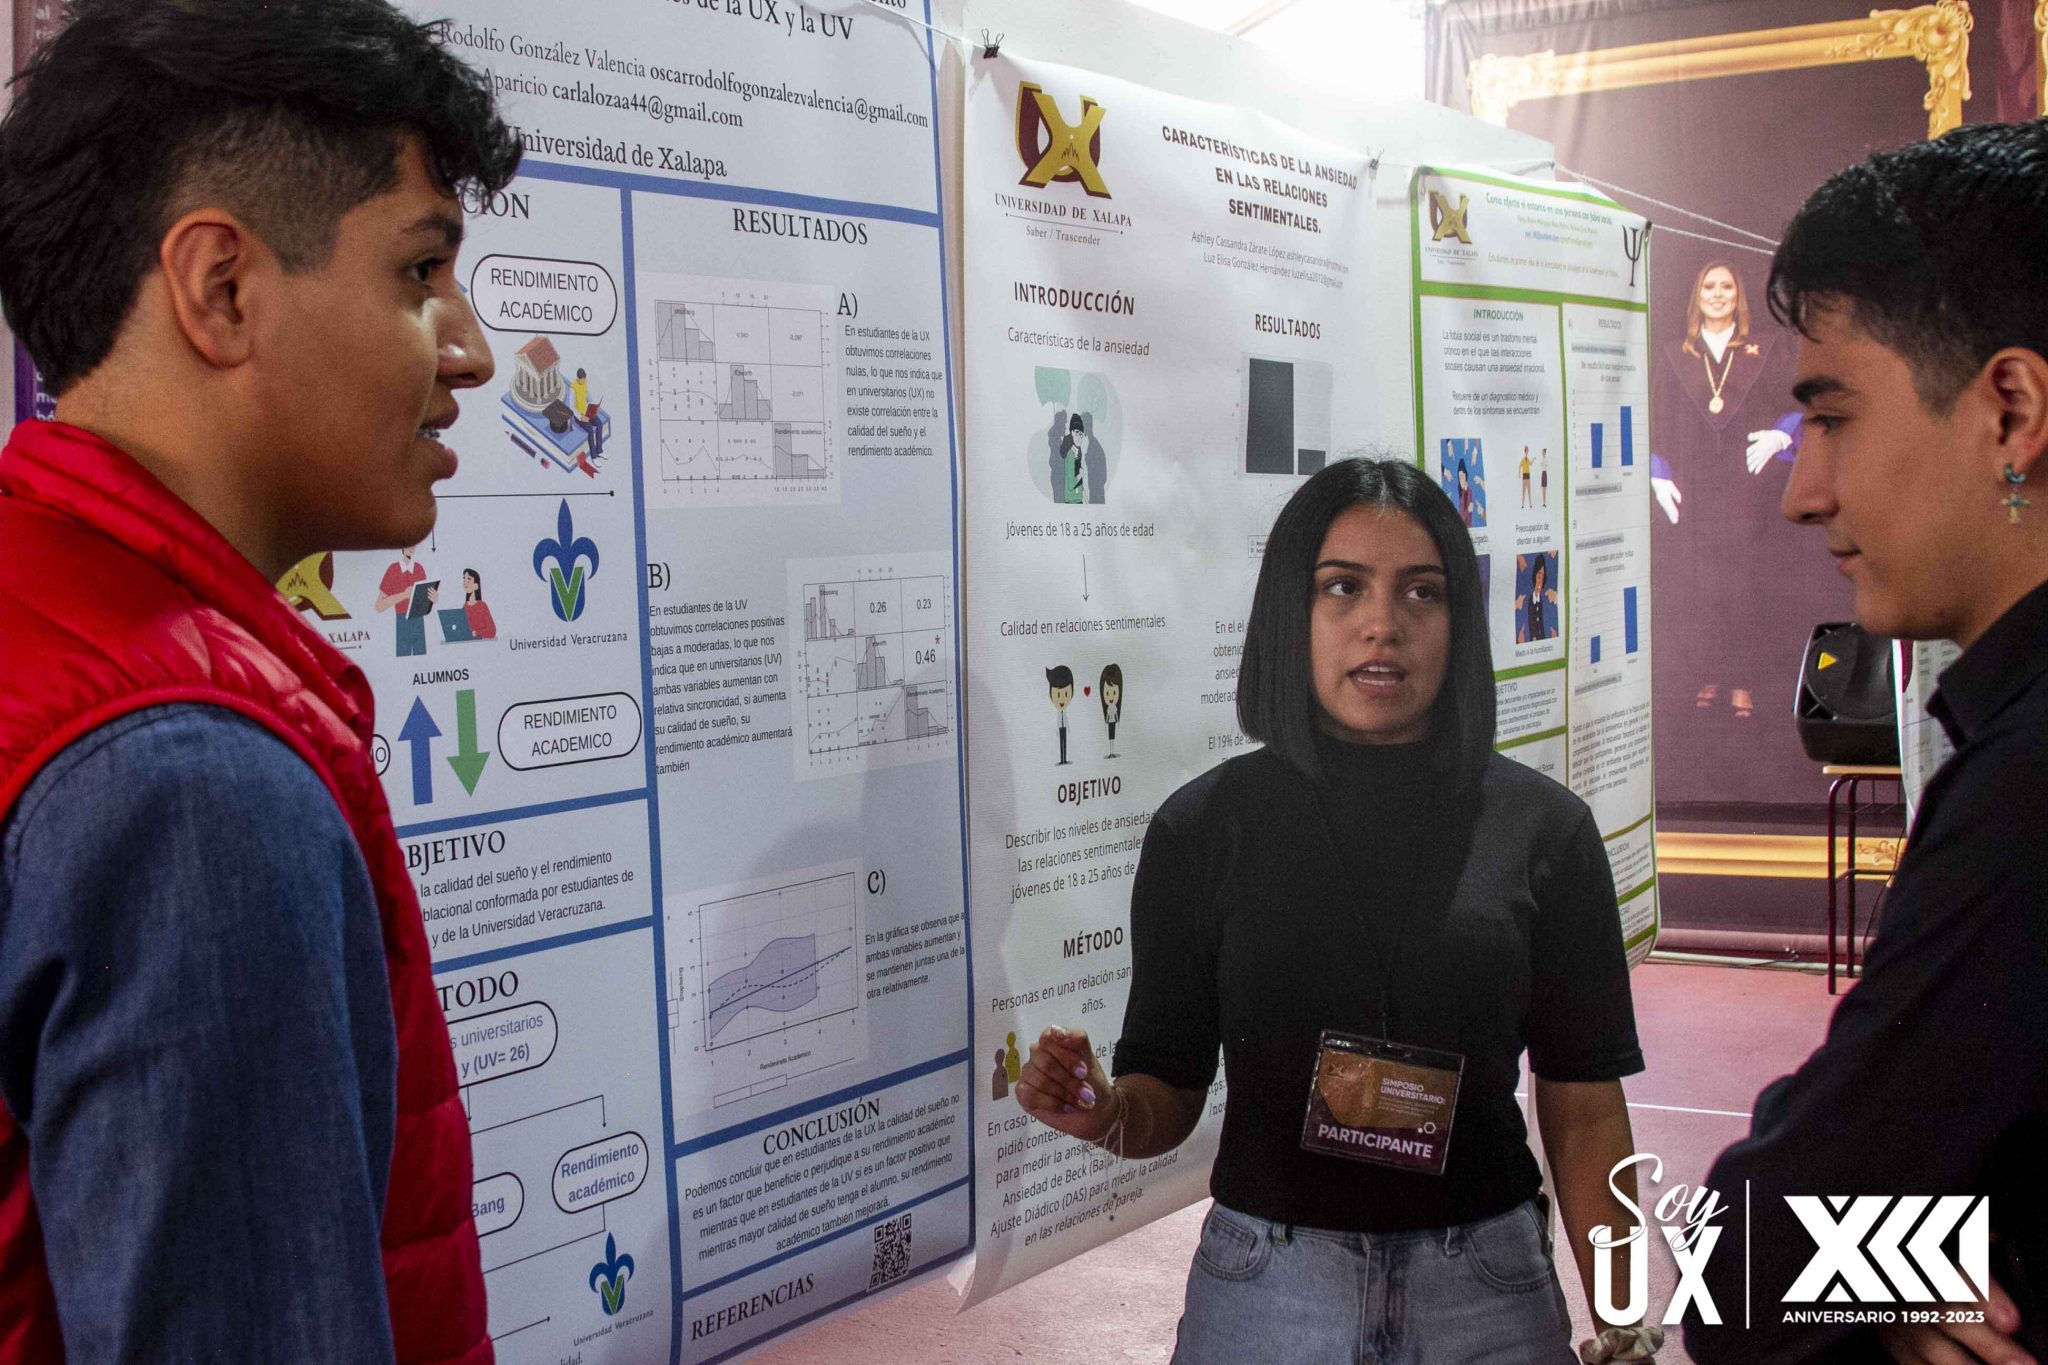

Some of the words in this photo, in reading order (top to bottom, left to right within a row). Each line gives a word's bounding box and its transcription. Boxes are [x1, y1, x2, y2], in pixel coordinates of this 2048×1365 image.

[750, 0, 780, 24] UX
[785, 12, 795, 36] y
[801, 5, 815, 33] la
[821, 13, 853, 40] UV
[441, 23, 504, 52] Rodolfo
[510, 35, 580, 65] González
[585, 48, 645, 77] Valencia
[650, 66, 928, 128] oscarrodolfogonzalezvalencia@gmail.com
[483, 68, 547, 97] Aparicio
[553, 82, 743, 127] carlalozaa44@gmail.com
[632, 145, 653, 167] de
[658, 147, 727, 179] Xalapa
[1280, 155, 1295, 171] DE
[1298, 159, 1312, 176] LA
[1315, 164, 1357, 190] ANSIEDAD
[1216, 167, 1233, 185] EN
[1237, 170, 1260, 190] LAS
[1263, 178, 1327, 208] RELACIONES
[995, 193, 1066, 217] UNIVERSIDAD
[1072, 205, 1087, 220] DE
[1093, 209, 1132, 227] XALAPA
[1229, 199, 1321, 234] SENTIMENTALES.
[732, 208, 868, 244] RESULTADOS
[1026, 225, 1047, 238] Saber
[1056, 229, 1101, 246] Trascender
[1192, 232, 1214, 247] Ashley
[1216, 236, 1247, 251] Cassandra
[1249, 241, 1268, 255] Zárate
[1269, 246, 1285, 259] López
[491, 268, 598, 292] RENDIMIENTO
[499, 300, 593, 322] ACADÉMICO
[837, 293, 858, 319] A)
[1014, 281, 1134, 315] INTRODUCCIÓN
[1255, 313, 1321, 340] RESULTADOS
[1474, 309, 1523, 321] INTRODUCCIÓN
[845, 325, 856, 336] En
[858, 326, 899, 339] estudiantes
[901, 328, 909, 339] de
[911, 328, 918, 340] la
[920, 331, 930, 341] UX
[1077, 336, 1089, 351] de
[1092, 337, 1101, 352] la
[1104, 339, 1149, 356] ansiedad
[846, 347, 884, 359] obtuvimos
[886, 348, 931, 360] correlaciones
[849, 444, 892, 457] rendimiento
[1006, 521, 1043, 539] Jóvenes
[1046, 522, 1057, 537] de
[1060, 523, 1070, 536] 18
[1073, 526, 1079, 536] a
[1081, 523, 1092, 536] 25
[1095, 521, 1118, 536] años
[1121, 523, 1130, 536] de
[1133, 523, 1154, 537] edad
[648, 563, 671, 589] B)
[650, 605, 661, 617] En
[663, 601, 710, 615] estudiantes
[712, 601, 723, 612] de
[725, 600, 733, 611] la
[735, 599, 747, 610] UV
[870, 601, 886, 614] 0.26
[916, 598, 931, 610] 0.23
[651, 622, 693, 637] obtuvimos
[695, 618, 749, 634] correlaciones
[751, 615, 784, 631] positivas
[1001, 620, 1038, 636] Calidad
[1040, 623, 1053, 634] en
[1055, 618, 1103, 634] relaciones
[1105, 614, 1165, 630] sentimentales
[509, 636, 566, 652] Universidad
[571, 632, 628, 645] Veracruzana
[915, 649, 936, 664] 0.46
[412, 668, 469, 686] ALUMNOS
[524, 704, 617, 730] RENDIMIENTO
[531, 733, 612, 757] ACADEMICO
[655, 738, 704, 755] rendimiento
[706, 732, 749, 750] académico
[752, 726, 793, 745] aumentará
[656, 759, 689, 775] también
[1058, 775, 1121, 806] OBJETIVO
[406, 830, 506, 875] BJETIVO
[420, 884, 431, 898] la
[434, 875, 473, 896] calidad
[477, 871, 494, 888] del
[496, 866, 528, 884] sueño
[531, 864, 538, 878] y
[541, 860, 550, 875] el
[552, 851, 612, 872] rendimiento
[868, 869, 886, 895] C)
[432, 933, 438, 948] y
[442, 926, 456, 943] de
[460, 924, 469, 939] la
[472, 913, 535, 937] Universidad
[538, 899, 606, 922] Veracruzana.
[1063, 926, 1124, 959] MÉTODO
[436, 971, 518, 1012] TODO
[867, 987, 881, 999] otra
[461, 1015, 543, 1046] universitarios
[462, 1061, 469, 1078] y
[474, 1051, 506, 1075] (UV=
[510, 1043, 530, 1062] 26)
[1382, 1078, 1424, 1092] SIMPOSIO
[764, 1096, 881, 1155] CONCLUSIÓN
[1318, 1124, 1433, 1159] PARTICIPANTE
[561, 1142, 639, 1179] Rendimiento
[568, 1170, 634, 1203] académico
[990, 1215, 1022, 1238] Ajuste
[1025, 1201, 1059, 1223] Diádico
[1062, 1187, 1087, 1211] (DAS)
[1089, 1180, 1109, 1201] para
[1138, 1163, 1146, 1176] la
[1148, 1150, 1178, 1173] calidad
[776, 1227, 820, 1251] académico
[822, 1213, 853, 1235] también
[1025, 1233, 1036, 1246] en
[1039, 1226, 1052, 1240] las
[1055, 1203, 1105, 1235] relaciones
[690, 1273, 814, 1341] REFERENCIAS
[574, 1325, 612, 1346] Universidad
[615, 1310, 653, 1330] Veracruzana
